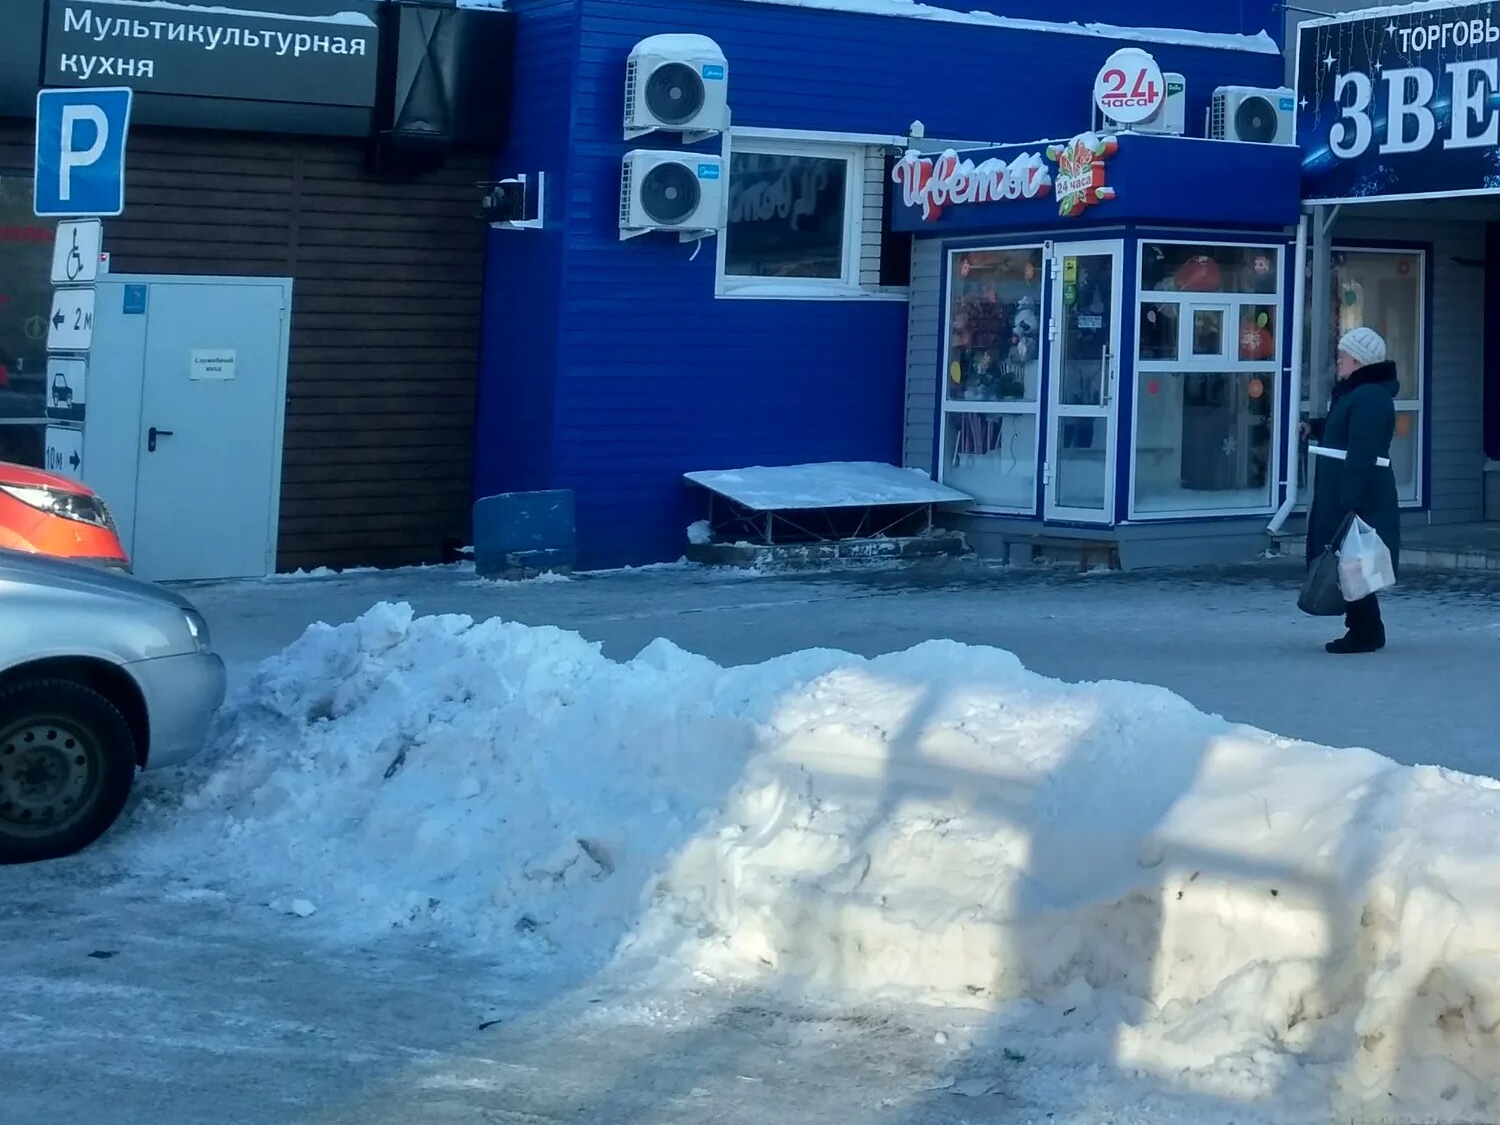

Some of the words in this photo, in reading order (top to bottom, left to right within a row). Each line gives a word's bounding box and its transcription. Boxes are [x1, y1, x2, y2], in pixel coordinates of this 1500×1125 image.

[63, 7, 366, 57] Мультикультурная
[60, 53, 154, 80] кухня
[1101, 68, 1159, 103] 24
[1101, 98, 1148, 108] часа
[58, 104, 110, 202] P
[892, 150, 1052, 221] Цветы
[74, 307, 82, 331] 2
